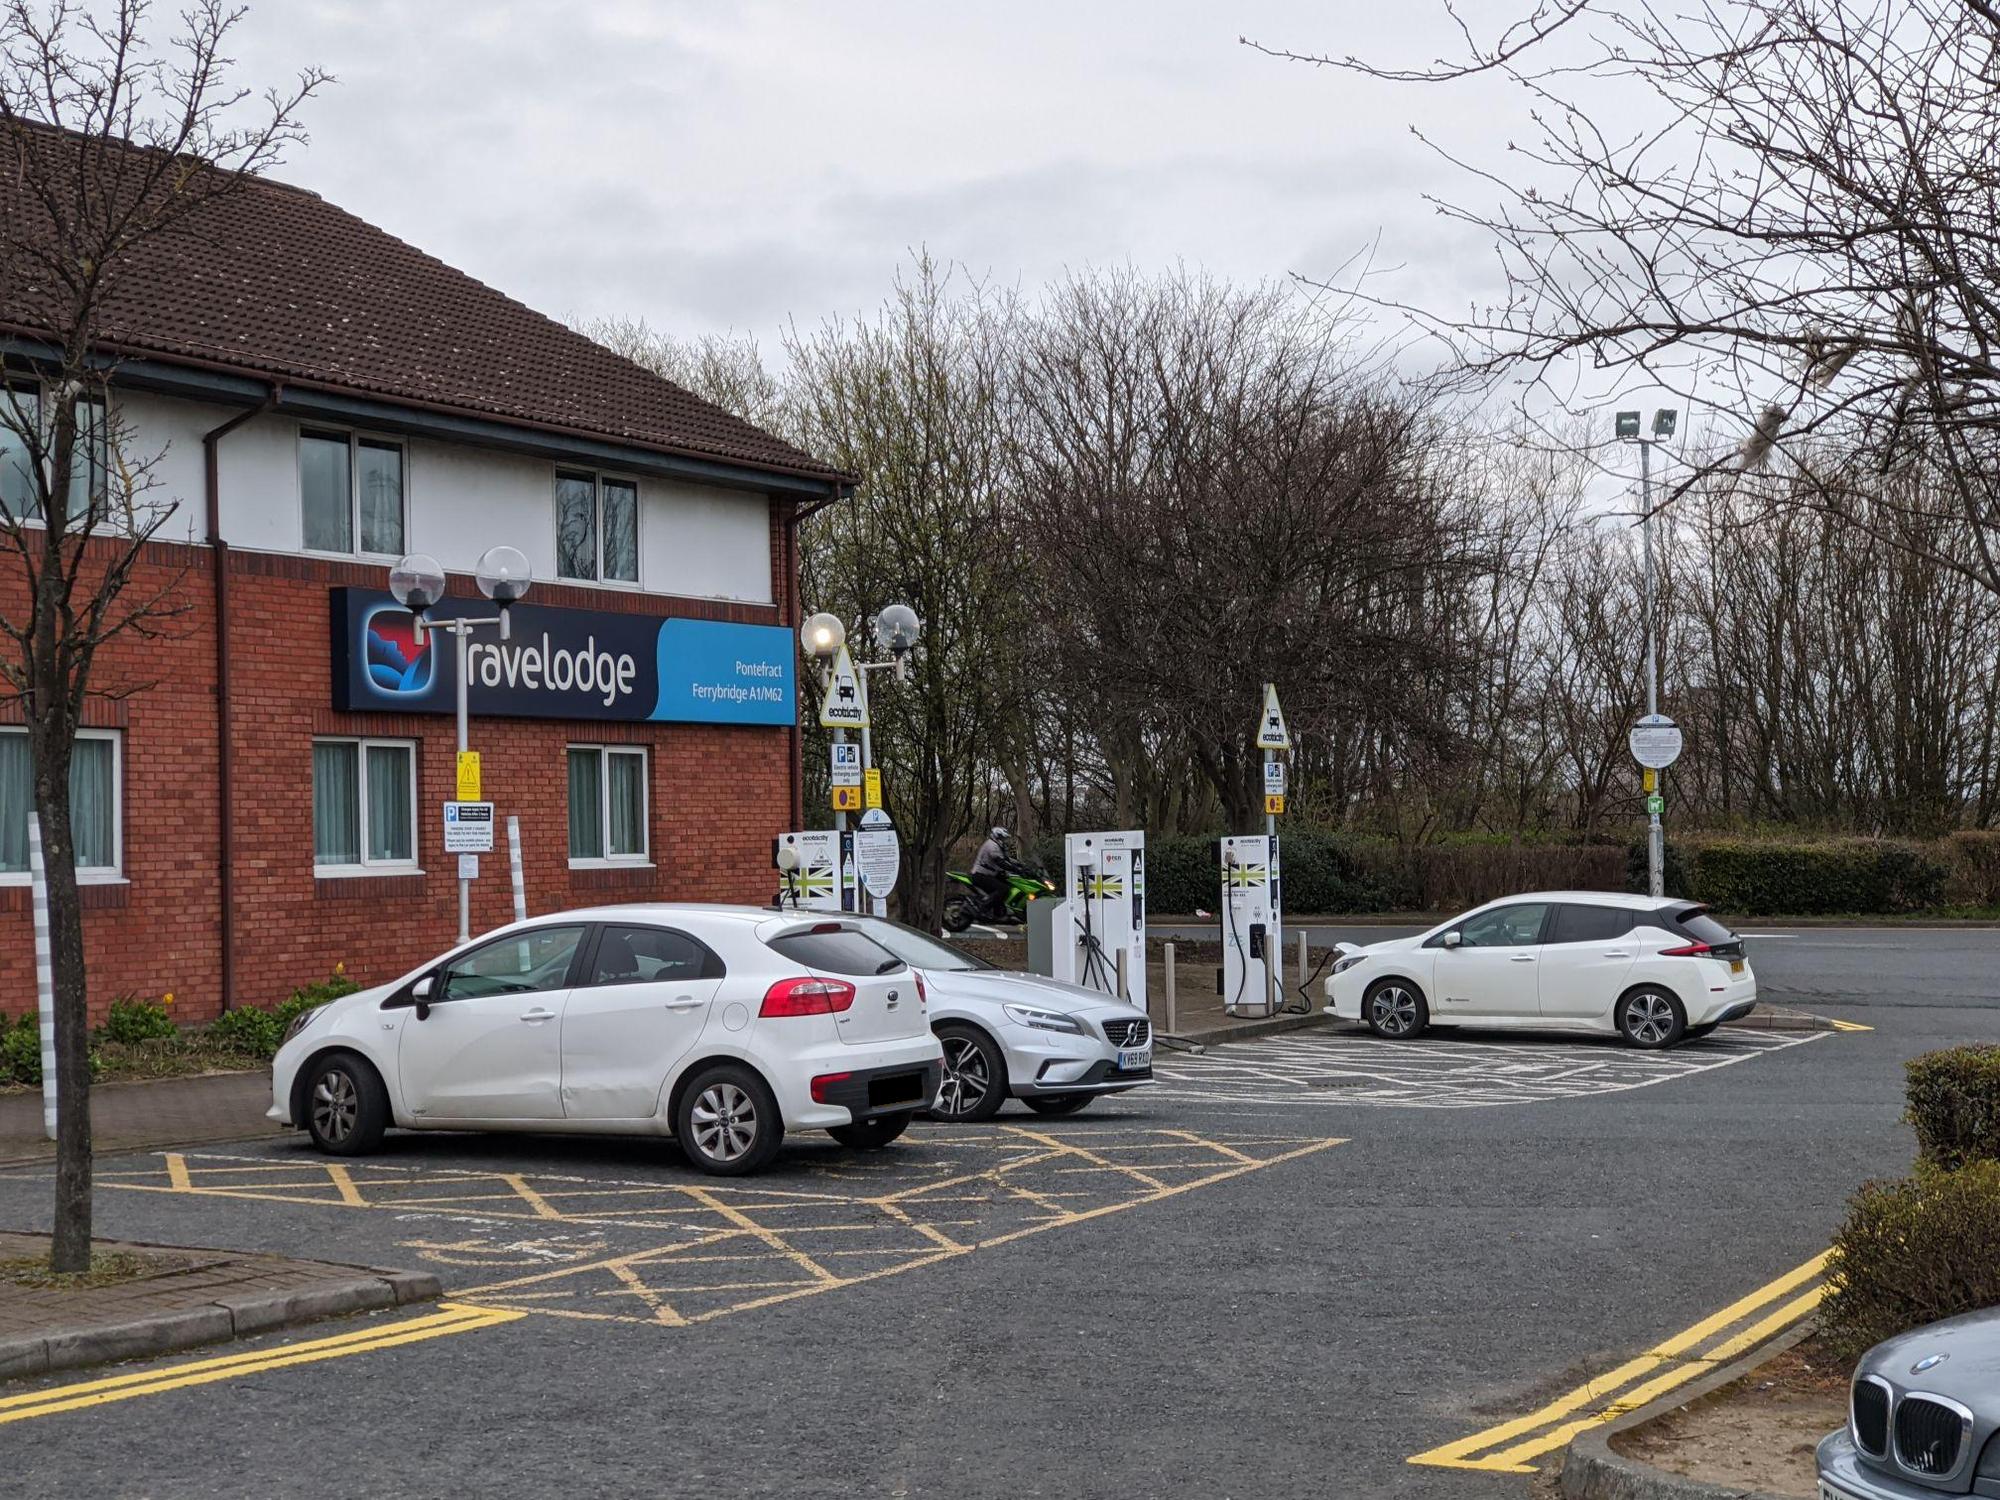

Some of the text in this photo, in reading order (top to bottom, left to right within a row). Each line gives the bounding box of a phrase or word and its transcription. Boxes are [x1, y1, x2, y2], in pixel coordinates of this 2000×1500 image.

[446, 626, 636, 706] ravelodge
[735, 660, 783, 678] Pontefract
[692, 683, 783, 704] Ferrybridge A1/M62
[828, 706, 862, 721] ecotricity
